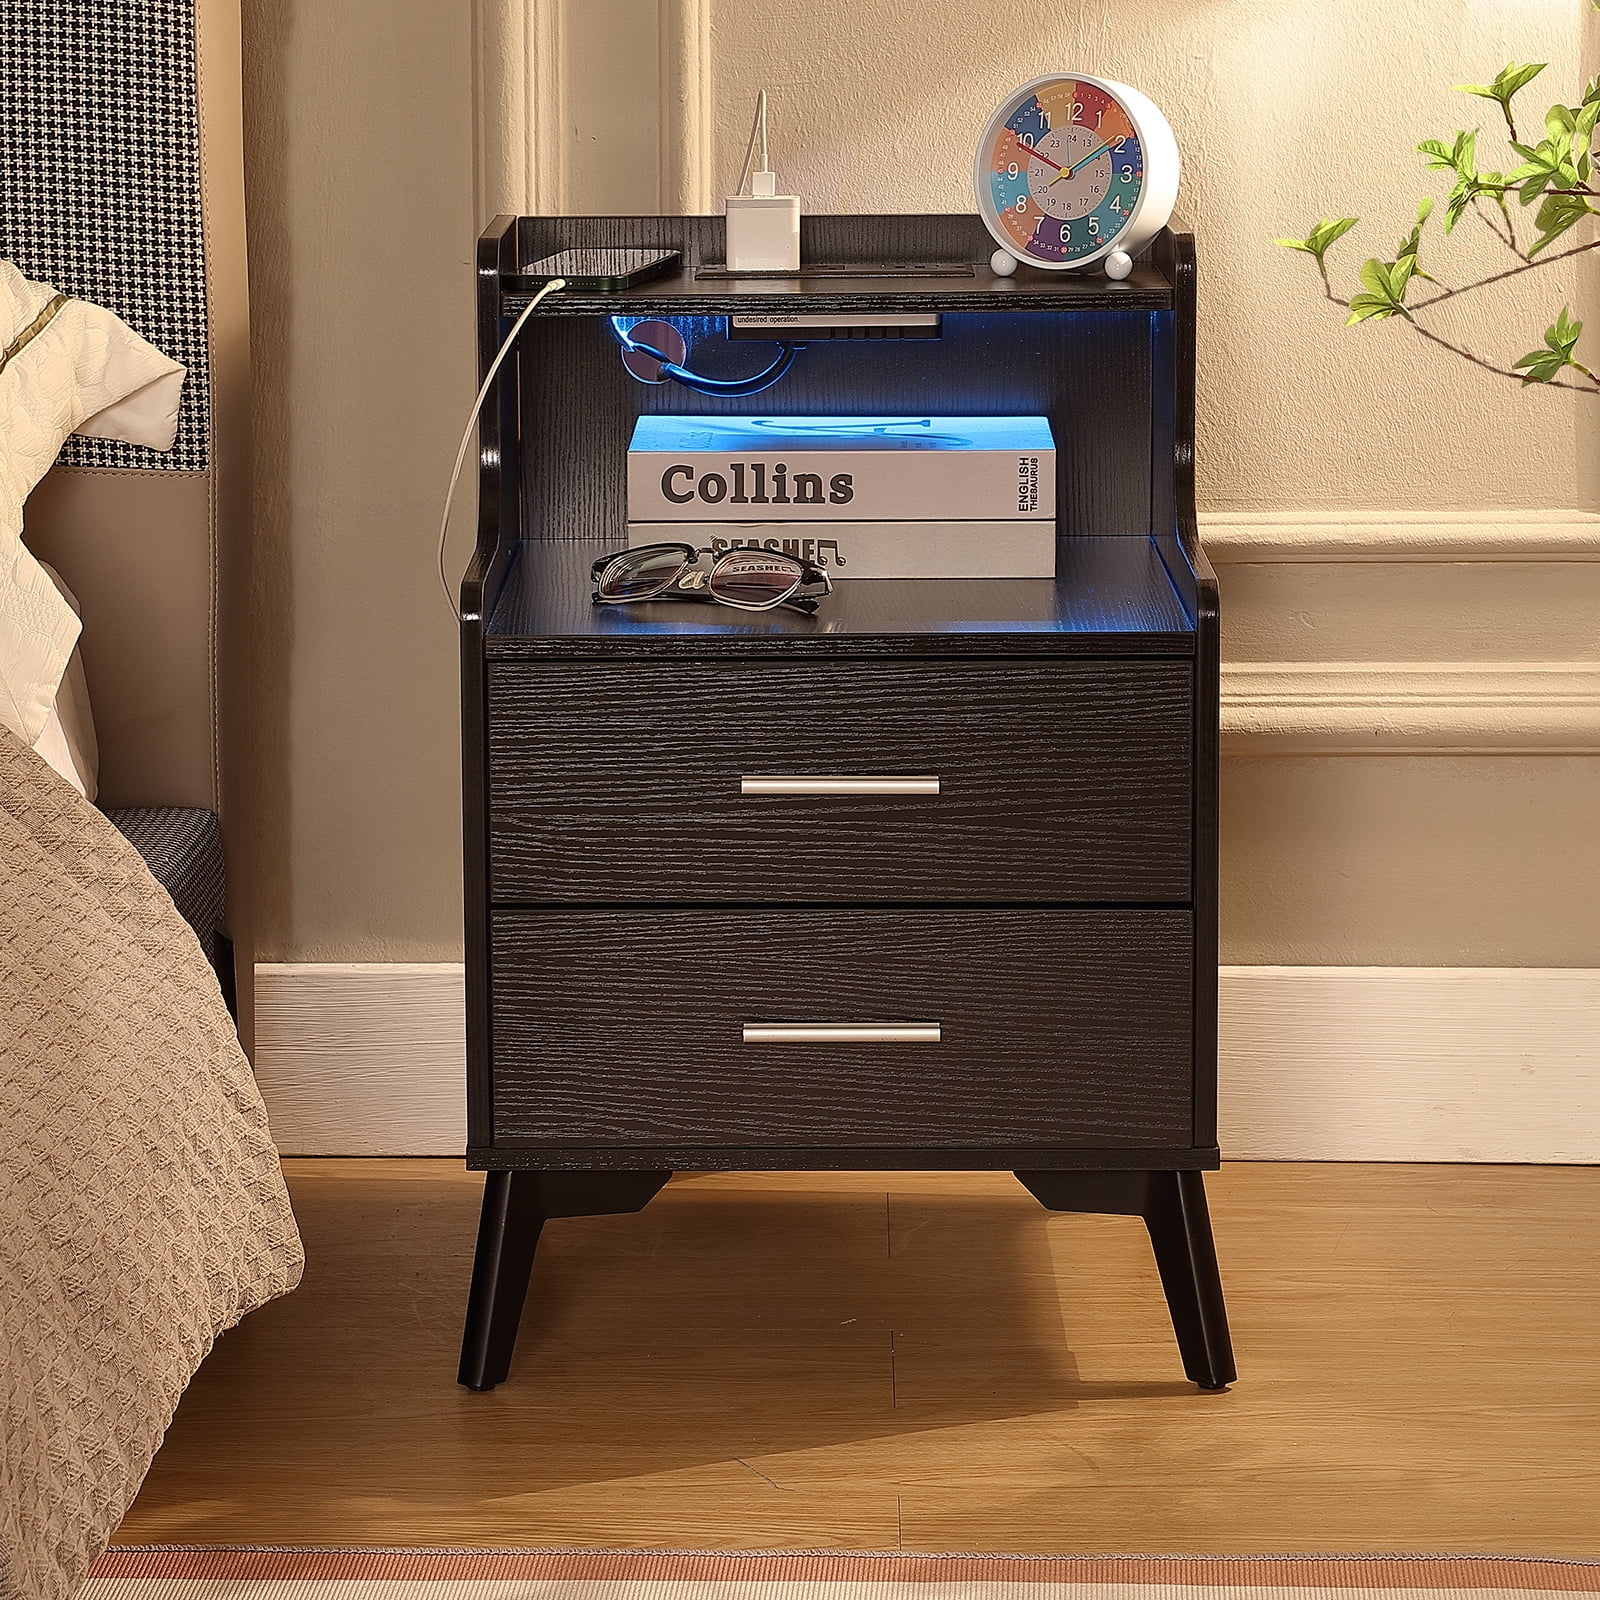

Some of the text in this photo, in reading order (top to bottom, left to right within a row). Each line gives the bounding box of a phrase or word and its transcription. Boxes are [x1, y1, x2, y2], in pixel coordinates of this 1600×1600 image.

[1038, 111, 1051, 129] 11
[1065, 102, 1083, 121] 12
[1096, 110, 1102, 129] 1
[1017, 133, 1034, 151] 10
[1050, 140, 1060, 148] 23
[1067, 135, 1077, 143] 24
[1083, 139, 1092, 147] 13
[1113, 135, 1126, 153] 2
[1007, 162, 1018, 180] 9
[1095, 170, 1105, 178] 15
[1120, 164, 1132, 183] 3
[1090, 185, 1099, 193] 16
[1015, 195, 1027, 213] 8
[1047, 198, 1056, 206] 19
[1080, 198, 1088, 206] 17
[1109, 195, 1121, 214] 4
[1034, 216, 1045, 235] 7
[1060, 224, 1071, 243] 6
[1088, 216, 1099, 235] 5
[660, 462, 854, 504] Collins
[1018, 457, 1029, 512] ENGLISH
[1029, 457, 1038, 512] THESAURUS
